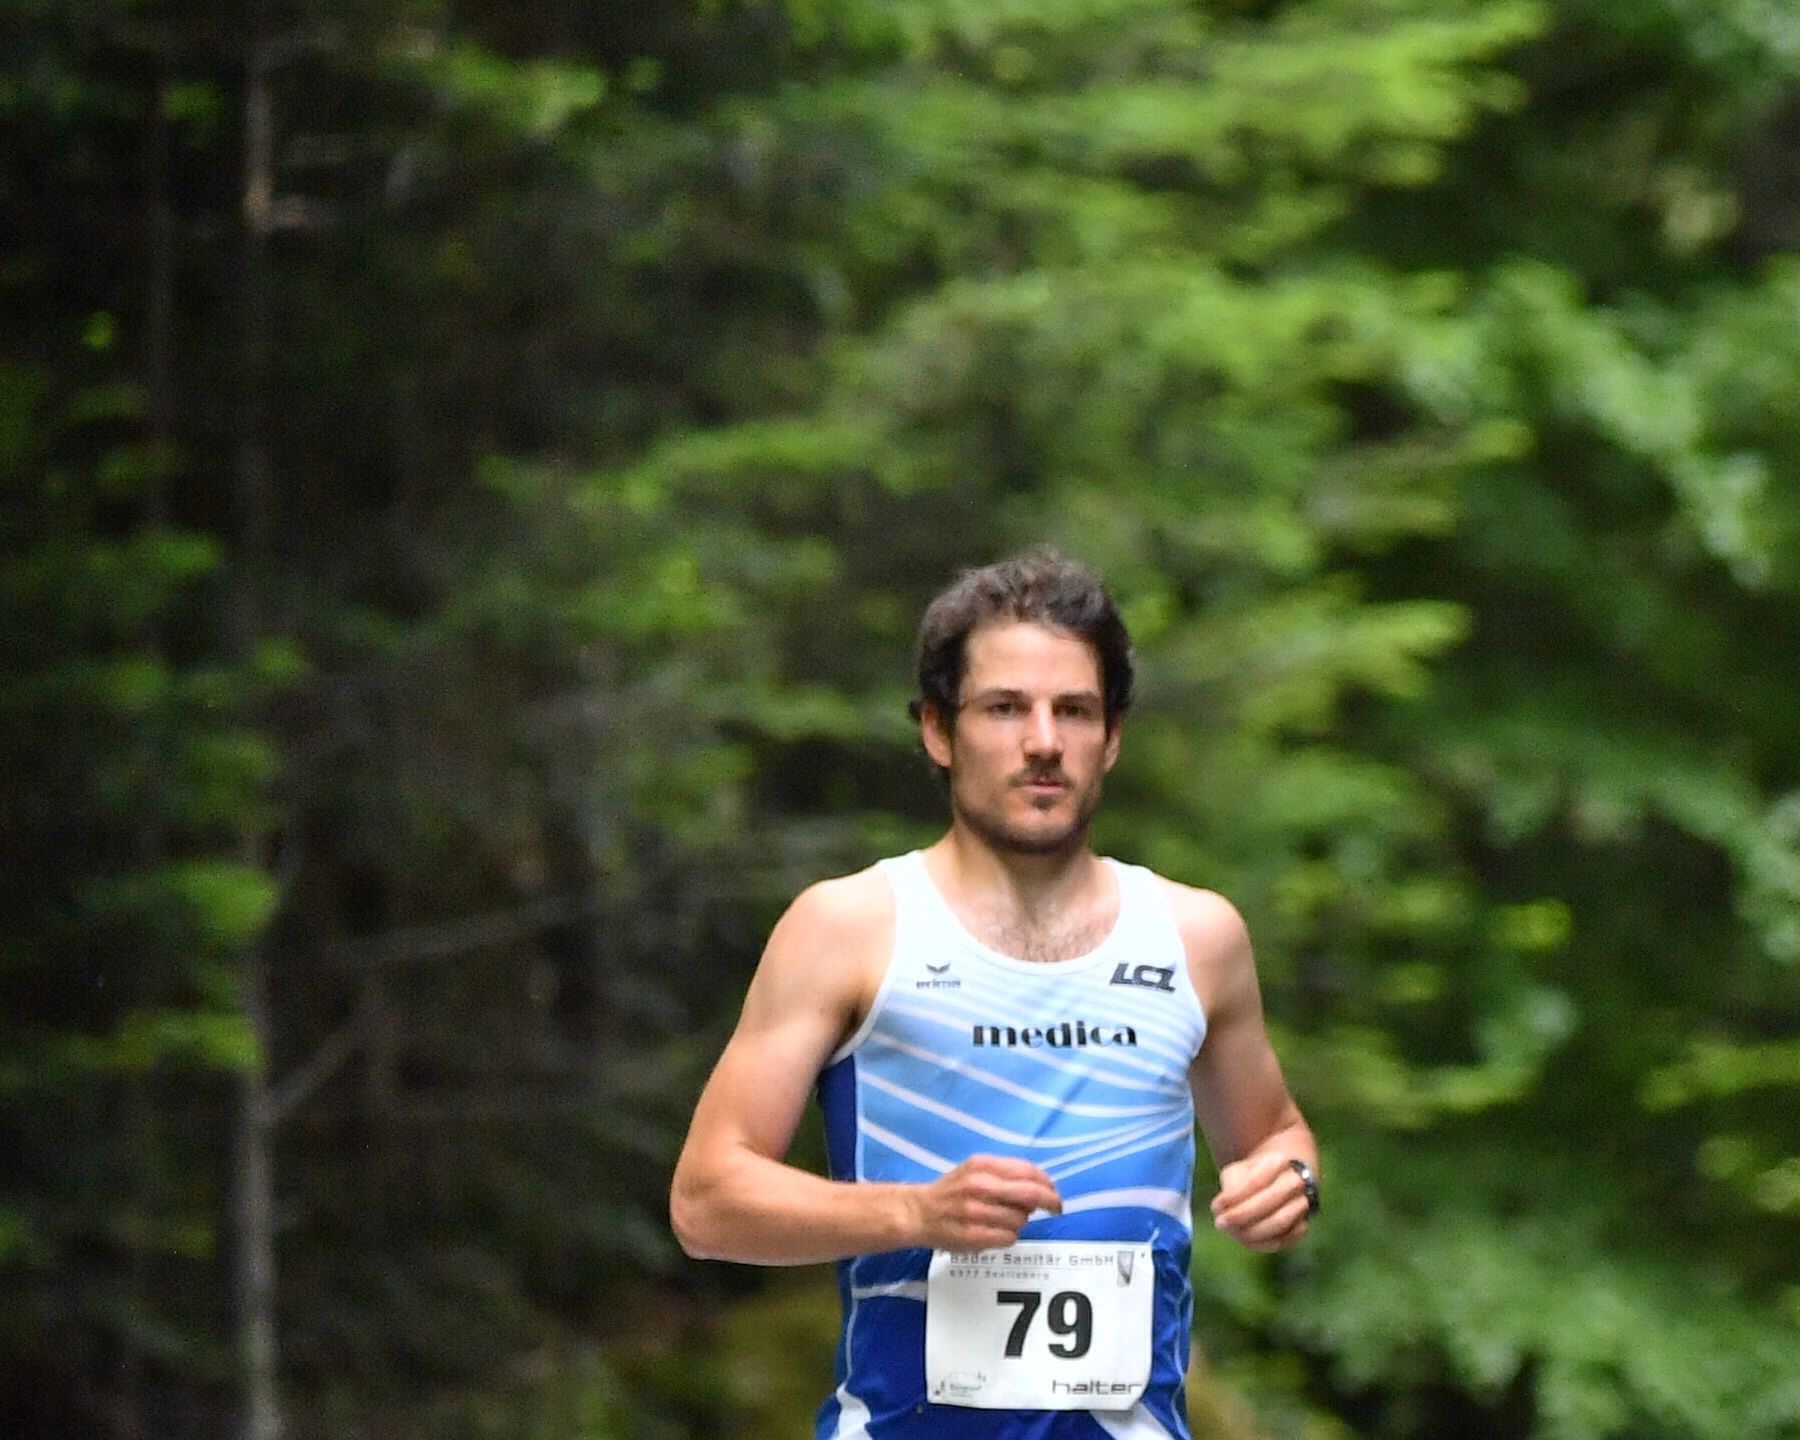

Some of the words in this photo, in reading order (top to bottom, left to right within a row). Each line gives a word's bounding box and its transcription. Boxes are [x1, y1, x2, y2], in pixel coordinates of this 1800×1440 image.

[916, 979, 961, 990] erima
[973, 1020, 1138, 1048] medica
[1003, 1254, 1061, 1266] Sanitär
[1069, 1255, 1114, 1266] GmbH
[997, 1291, 1093, 1359] 79
[1052, 1379, 1143, 1396] halter
